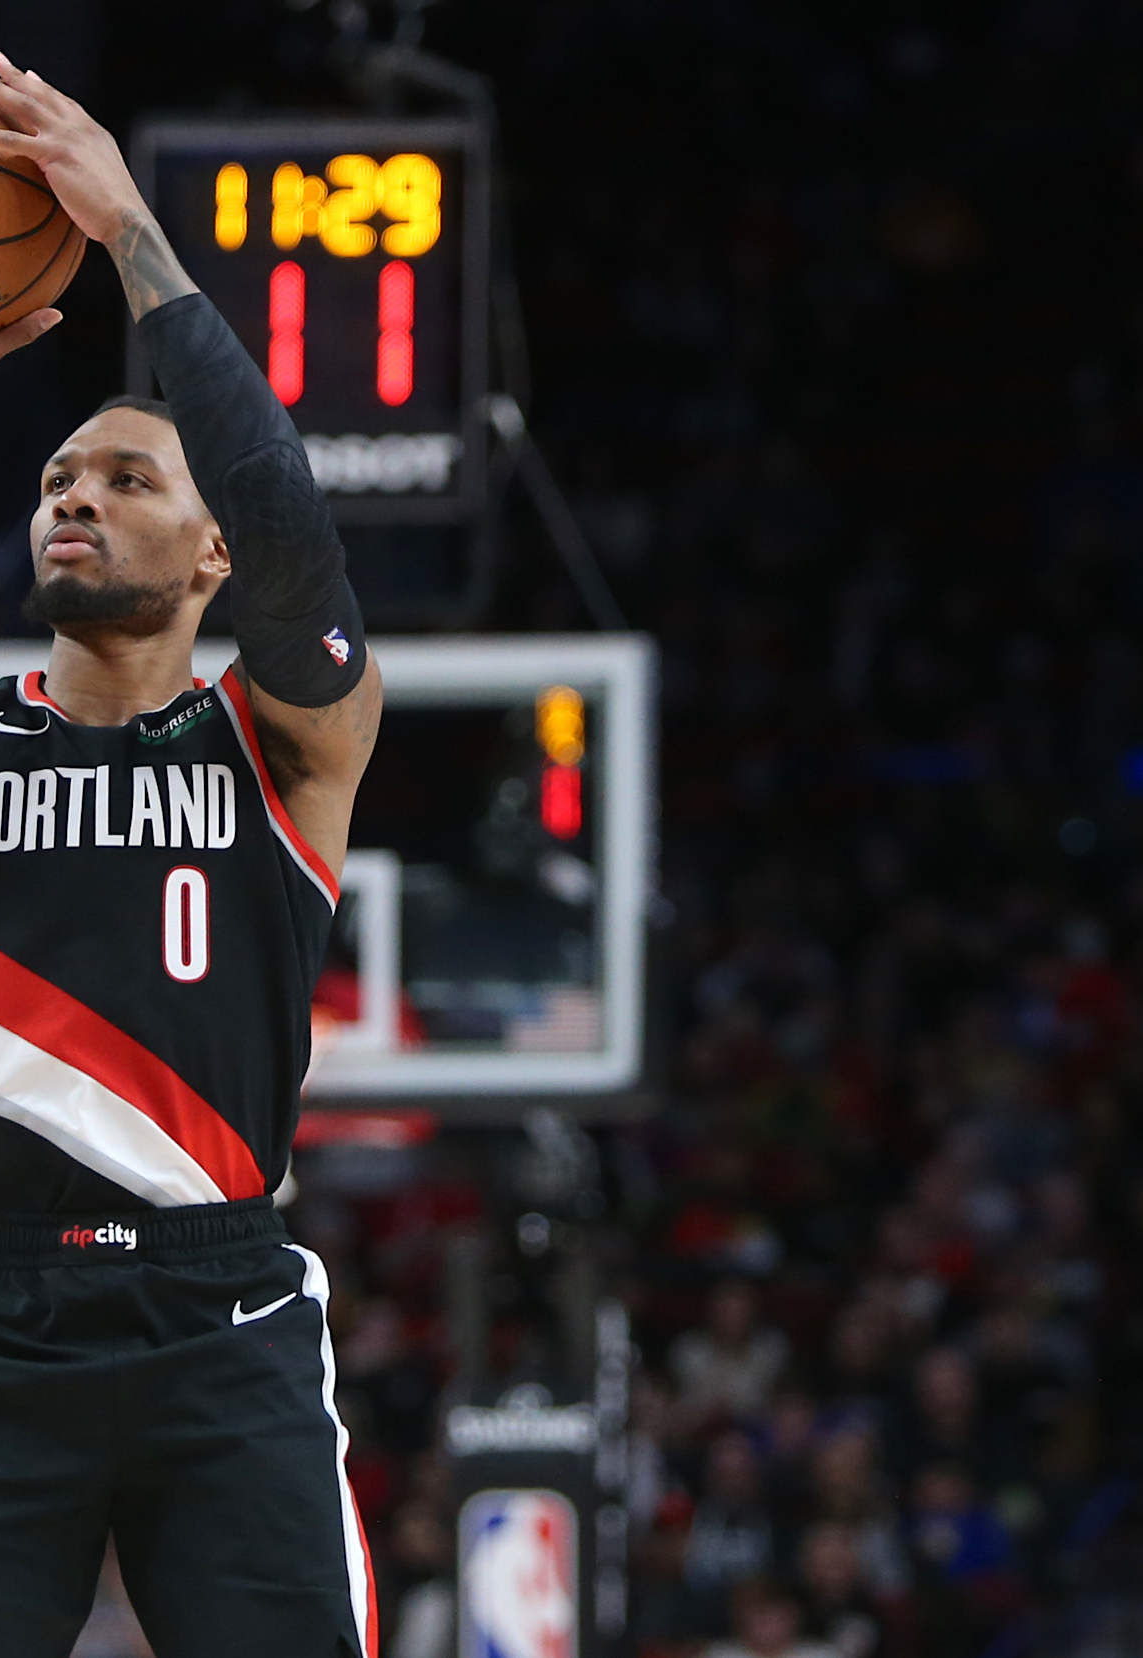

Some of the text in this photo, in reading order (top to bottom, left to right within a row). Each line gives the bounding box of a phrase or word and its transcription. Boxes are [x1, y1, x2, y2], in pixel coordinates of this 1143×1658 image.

[215, 153, 441, 257] 11:29
[139, 696, 213, 738] BIOFREEZE
[162, 864, 211, 984] 0
